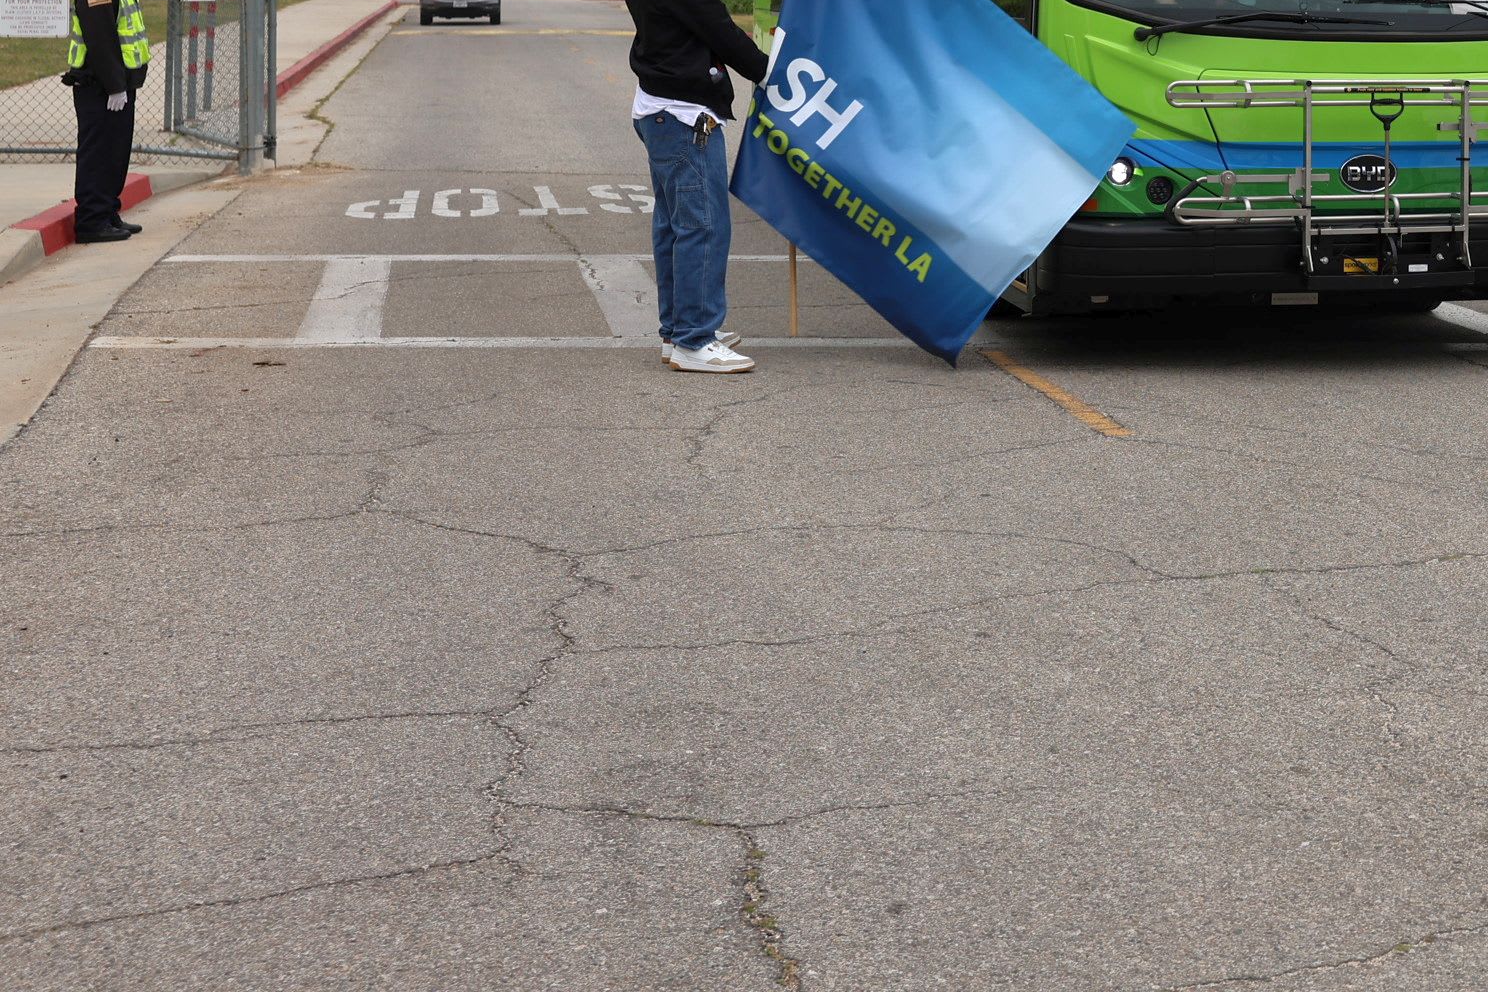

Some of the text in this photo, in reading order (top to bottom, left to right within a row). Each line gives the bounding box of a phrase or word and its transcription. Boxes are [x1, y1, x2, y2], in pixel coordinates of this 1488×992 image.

[1348, 166, 1386, 182] BYD
[345, 184, 656, 219] STOP
[752, 112, 933, 283] TOGETHER LA
